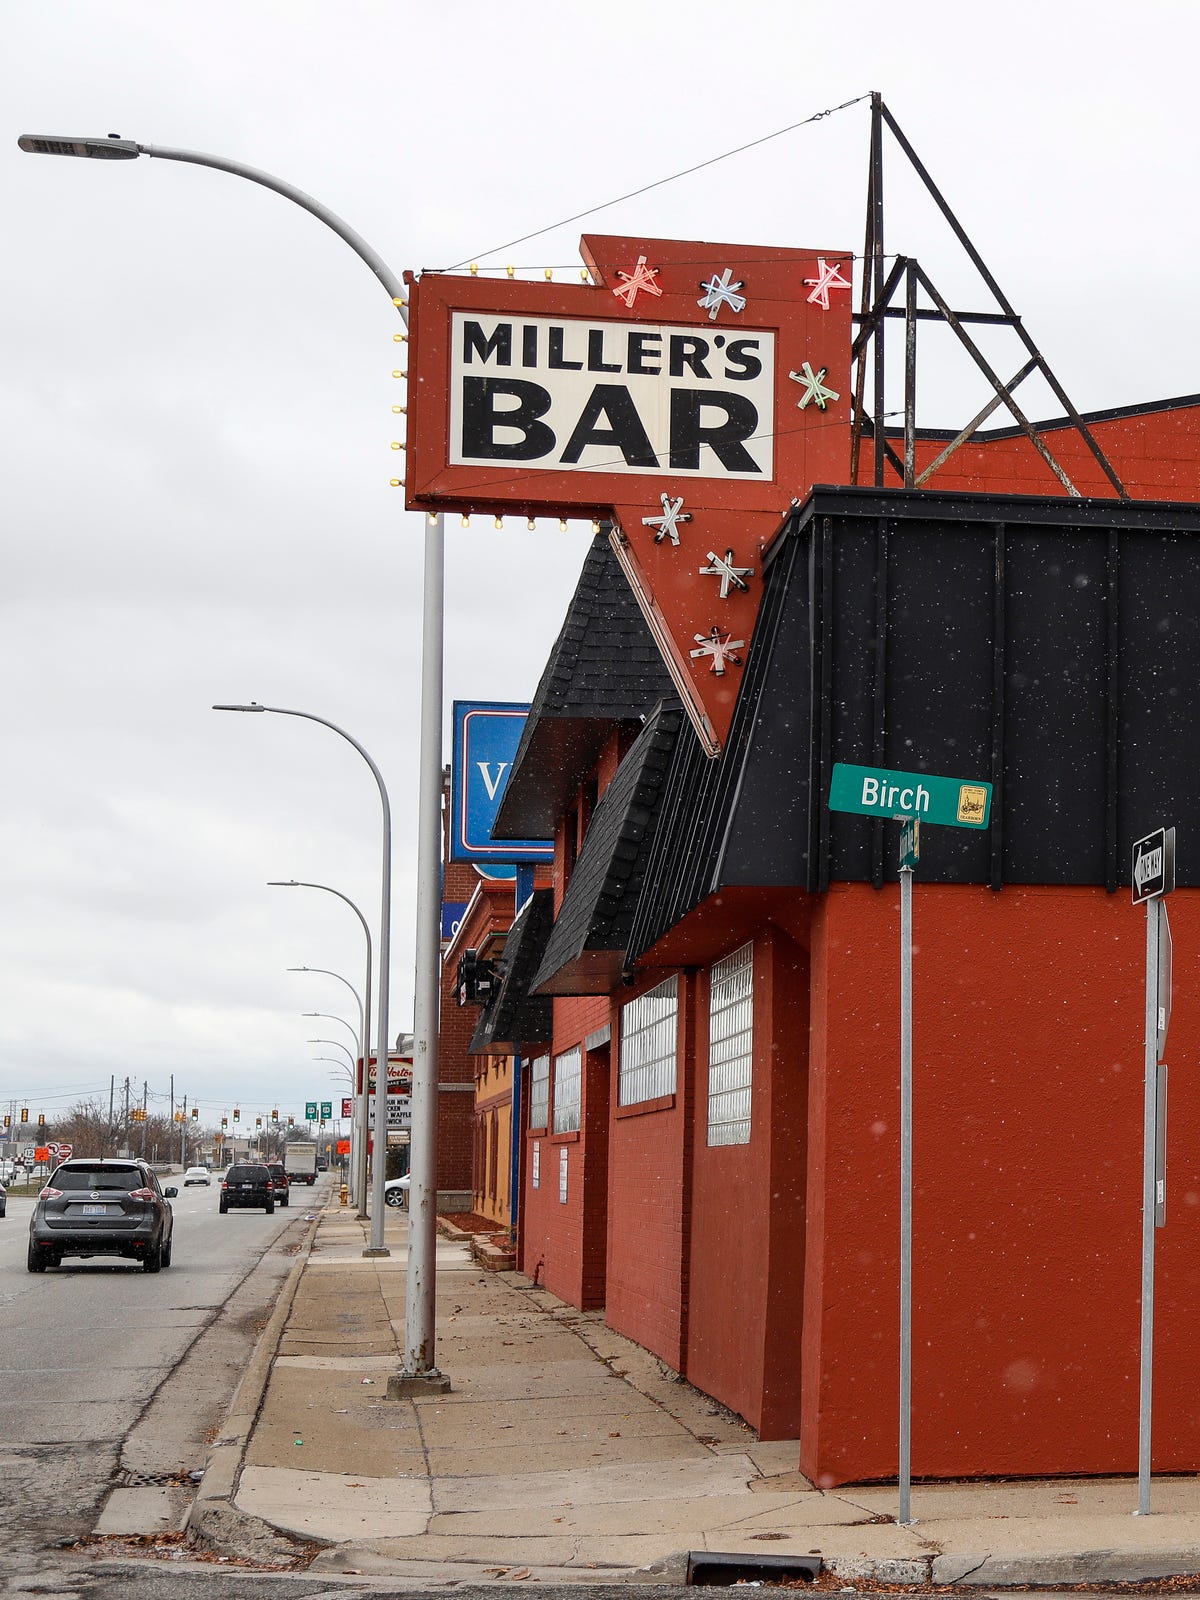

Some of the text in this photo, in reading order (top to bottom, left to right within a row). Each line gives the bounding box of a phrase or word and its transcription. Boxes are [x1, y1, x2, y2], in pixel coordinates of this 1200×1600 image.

[463, 320, 763, 381] MILLER'S
[461, 375, 764, 473] BAR
[861, 777, 930, 812] Birch
